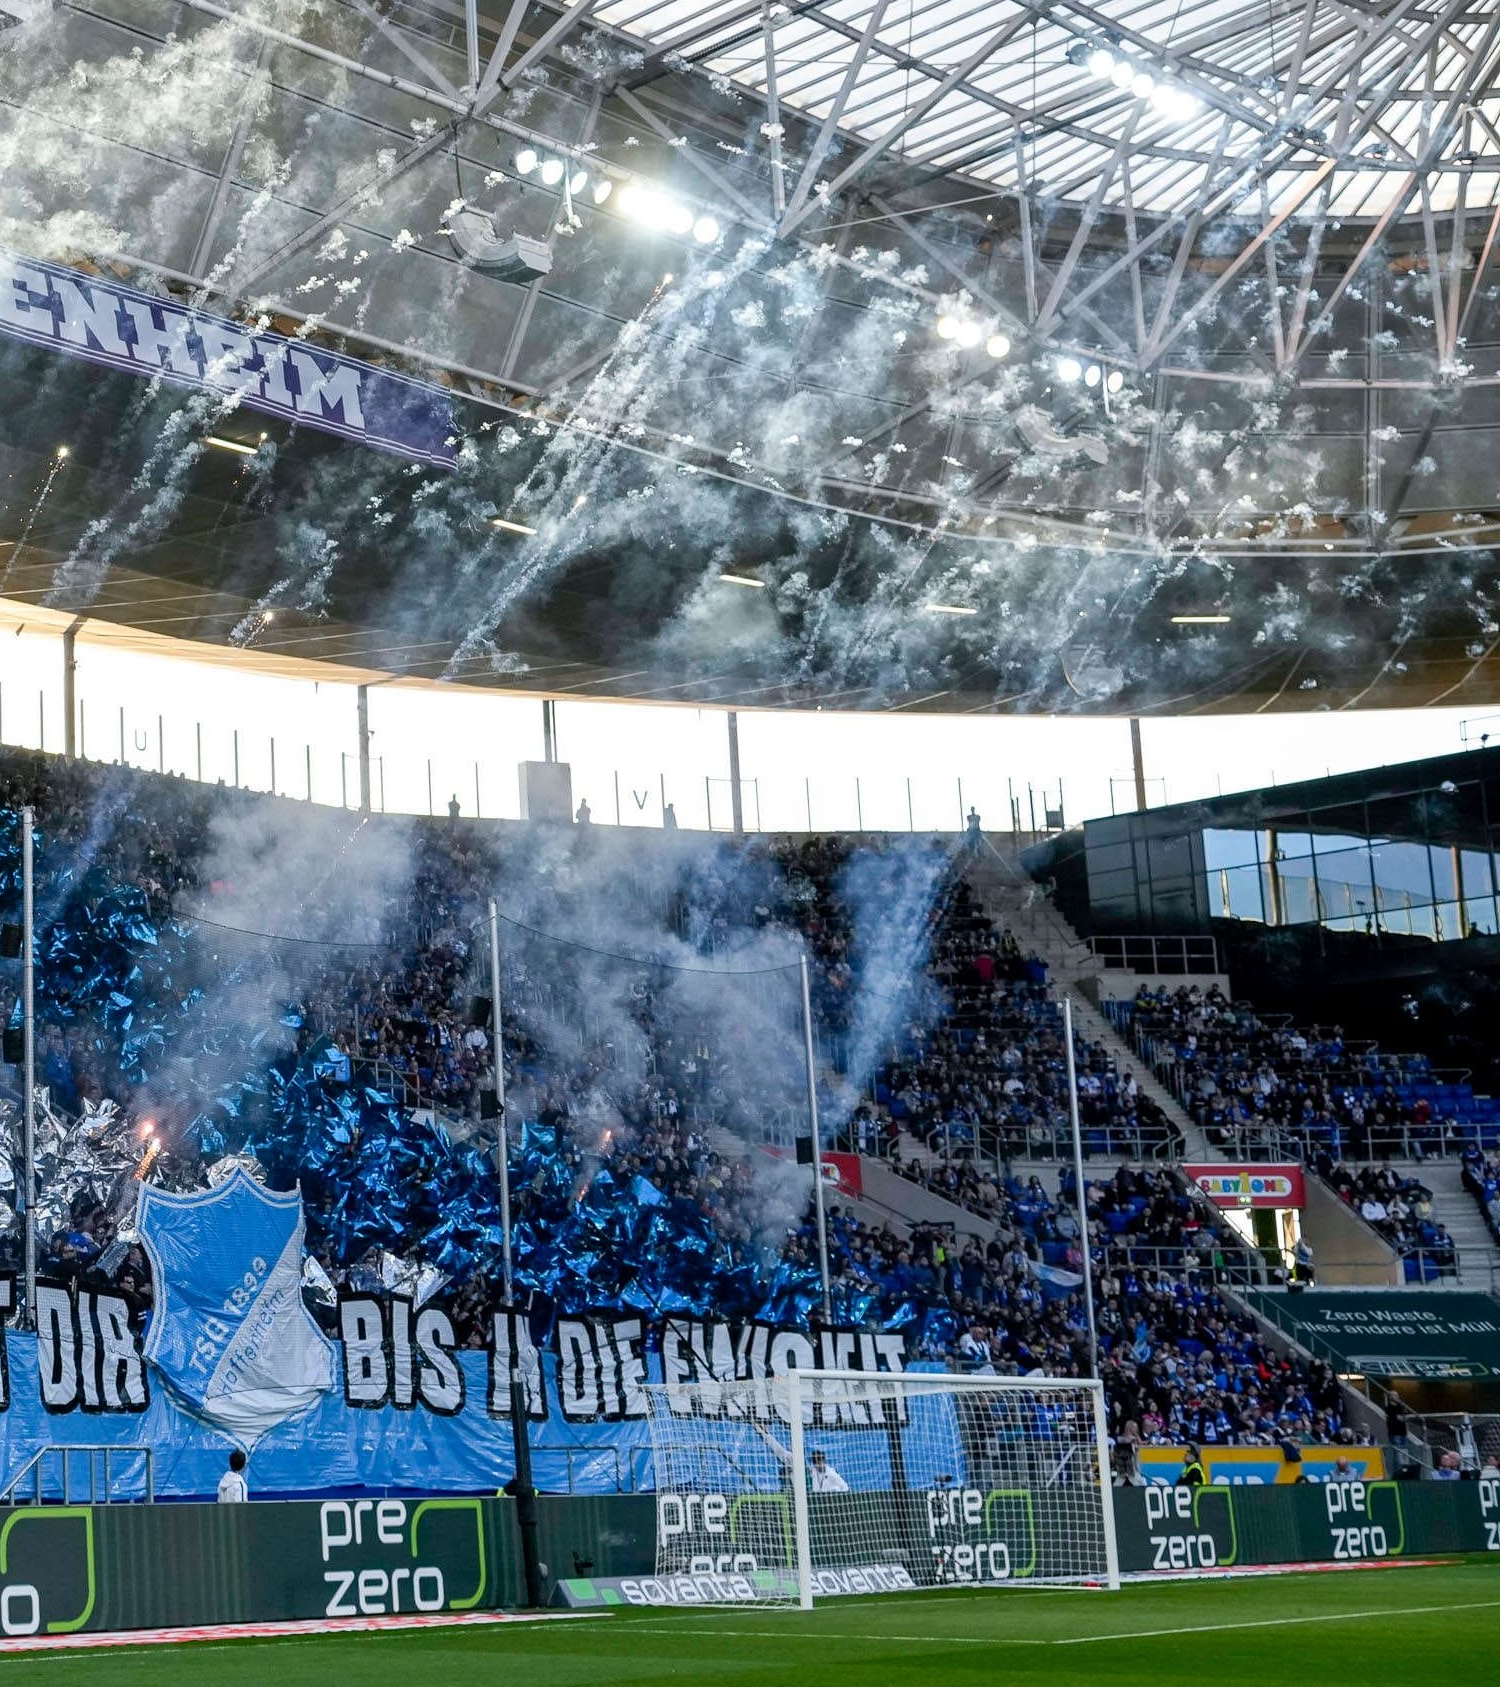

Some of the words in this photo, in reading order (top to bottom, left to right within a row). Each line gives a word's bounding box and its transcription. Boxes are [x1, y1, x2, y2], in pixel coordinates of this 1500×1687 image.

[134, 729, 147, 751] U
[632, 790, 648, 810] V
[223, 1256, 267, 1315] 1899
[1319, 1309, 1367, 1321] Zero
[1368, 1309, 1443, 1321] Waste.
[1343, 1324, 1416, 1335] andere
[37, 1285, 146, 1407] DIR
[341, 1300, 463, 1416] BIS
[558, 1319, 648, 1415] DIE
[189, 1316, 230, 1374] TSG
[926, 1489, 983, 1538] pre
[1144, 1485, 1192, 1530] pre
[1325, 1481, 1366, 1523] pre
[1478, 1479, 1500, 1518] pr
[320, 1500, 407, 1562] pre
[659, 1493, 727, 1547] pre
[931, 1542, 1011, 1583] zero
[1150, 1534, 1217, 1570] zero
[1330, 1525, 1388, 1559] zero
[324, 1566, 445, 1617] zero
[620, 1573, 757, 1605] sovanta
